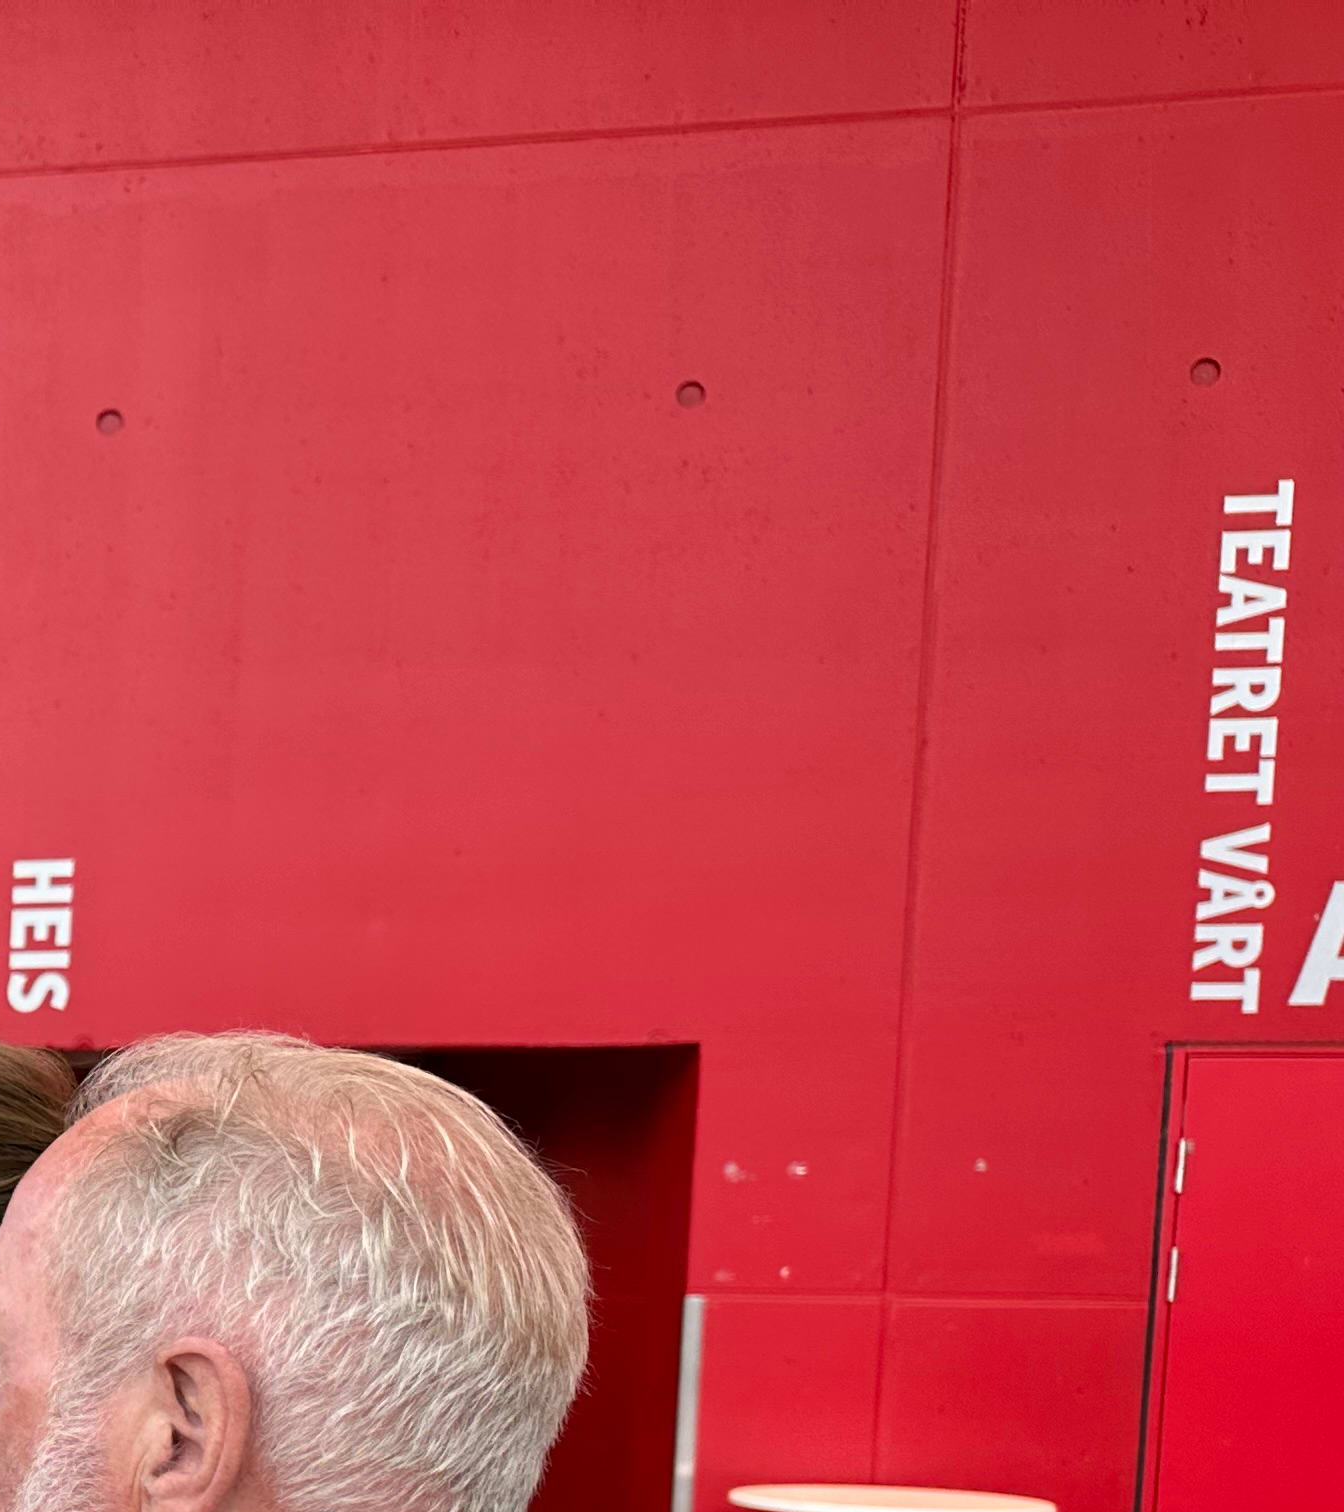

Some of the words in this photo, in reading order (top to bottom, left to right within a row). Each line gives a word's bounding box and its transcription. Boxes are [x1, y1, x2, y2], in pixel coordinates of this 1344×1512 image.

[1204, 479, 1295, 806] TEATRET
[7, 857, 76, 1014] HEIS
[1189, 822, 1276, 1014] VÅRT
